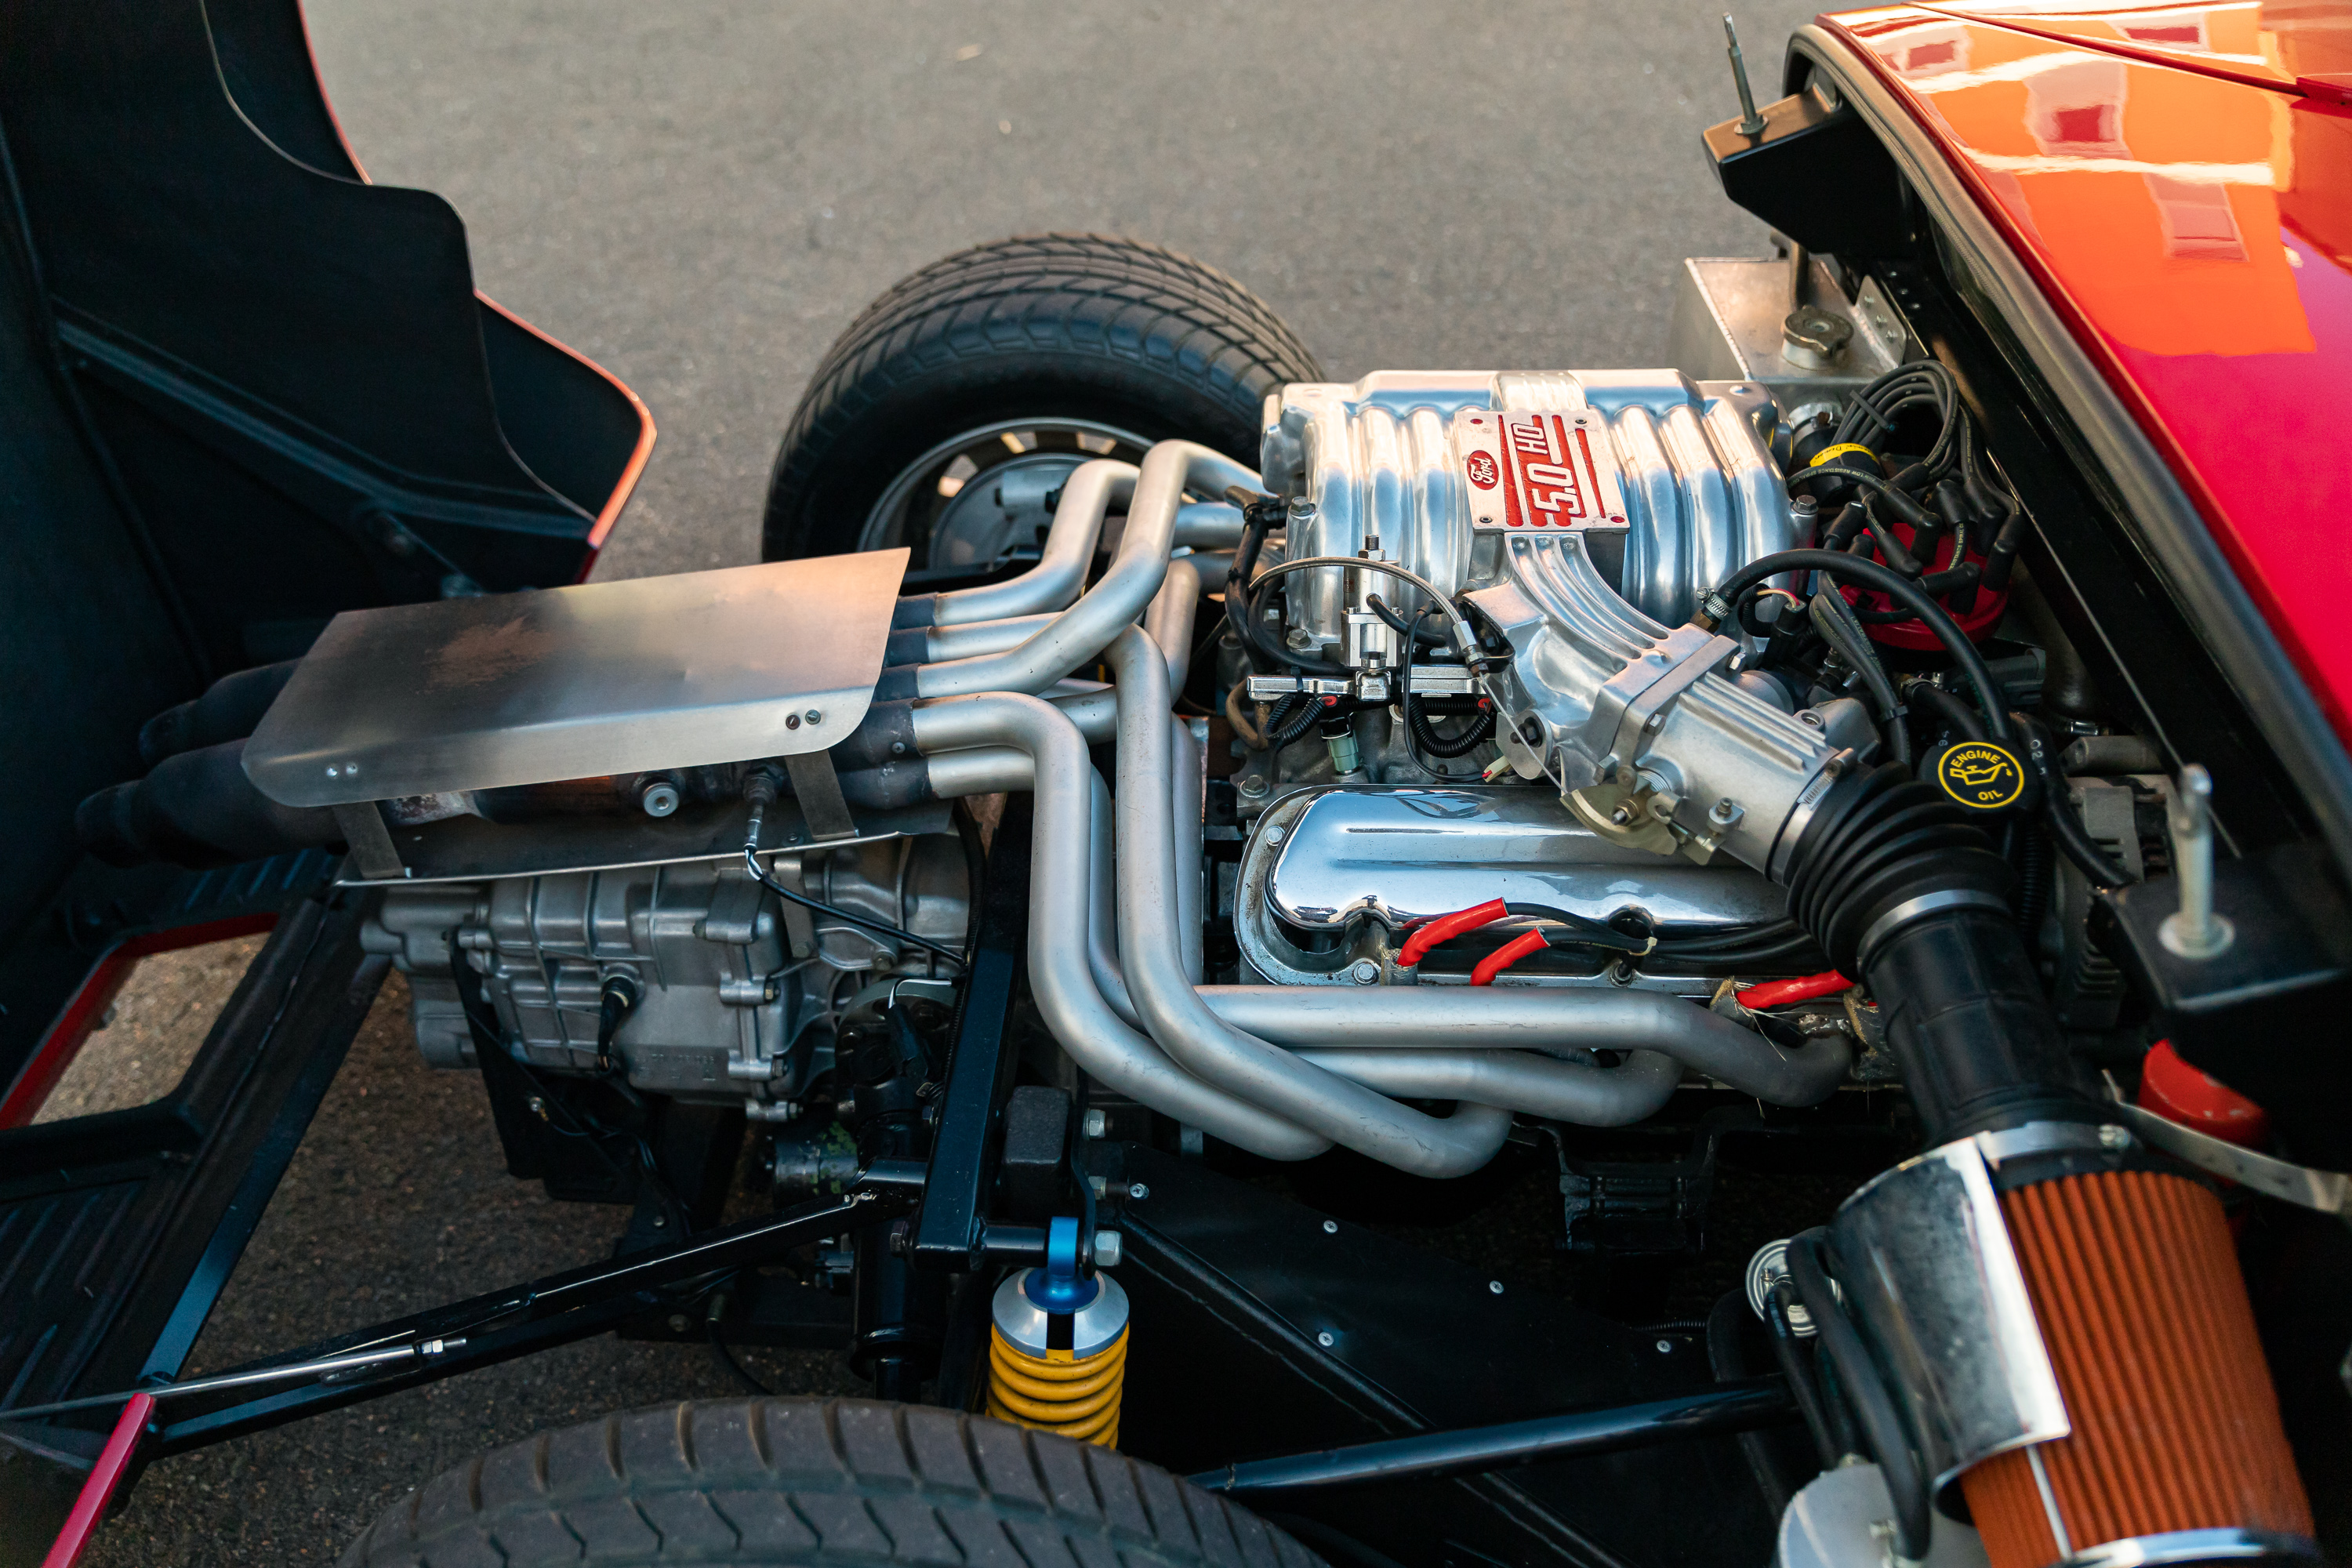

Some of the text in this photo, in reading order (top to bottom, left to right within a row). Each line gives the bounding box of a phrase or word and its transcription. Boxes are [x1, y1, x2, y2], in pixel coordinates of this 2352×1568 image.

[1470, 457, 1495, 484] Ford
[1512, 423, 1581, 515] 5.0 HO
[1950, 750, 2001, 768] ENGINE
[1978, 789, 2005, 801] OIL
